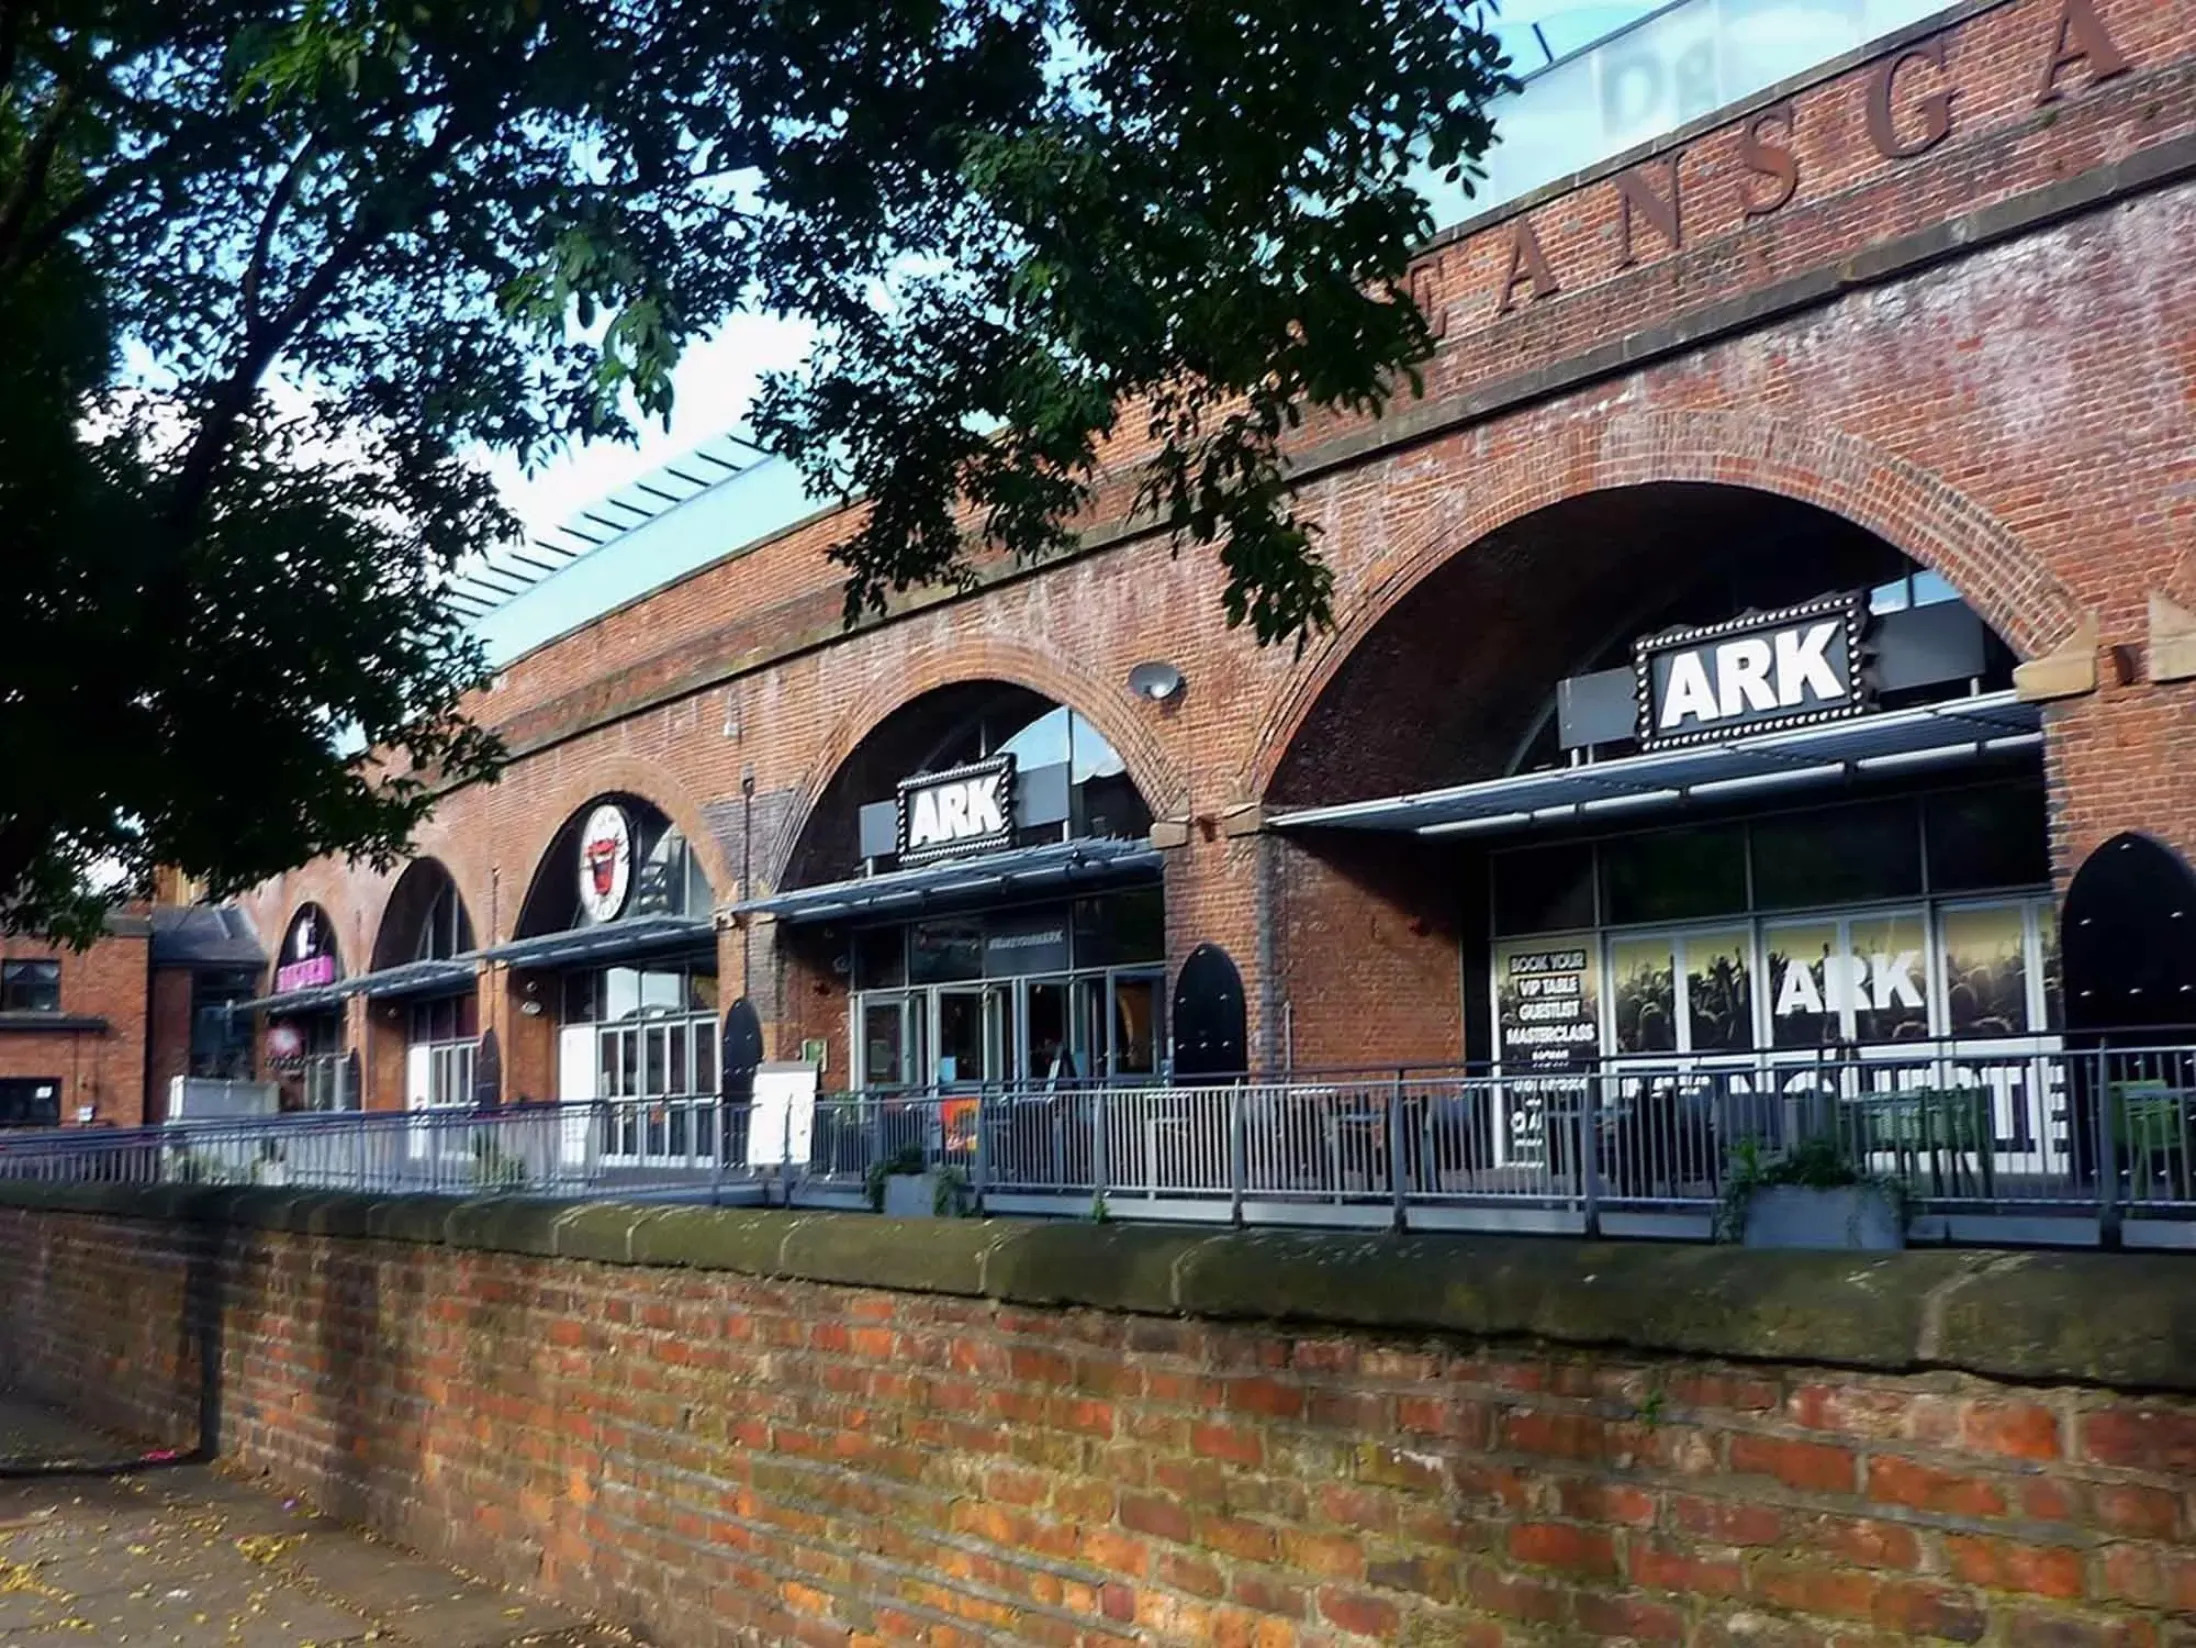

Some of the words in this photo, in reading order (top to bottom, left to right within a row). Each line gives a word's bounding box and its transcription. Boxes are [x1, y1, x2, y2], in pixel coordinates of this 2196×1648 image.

[1659, 620, 1846, 730] ARK
[908, 774, 1003, 848] ARK
[1511, 955, 1549, 973] BOOK
[1550, 951, 1584, 970] YOUR
[1775, 951, 1925, 1015] ARK
[1519, 979, 1541, 996] VIP
[1542, 976, 1578, 995] TABLE
[1519, 1000, 1580, 1021] GUESTLIST
